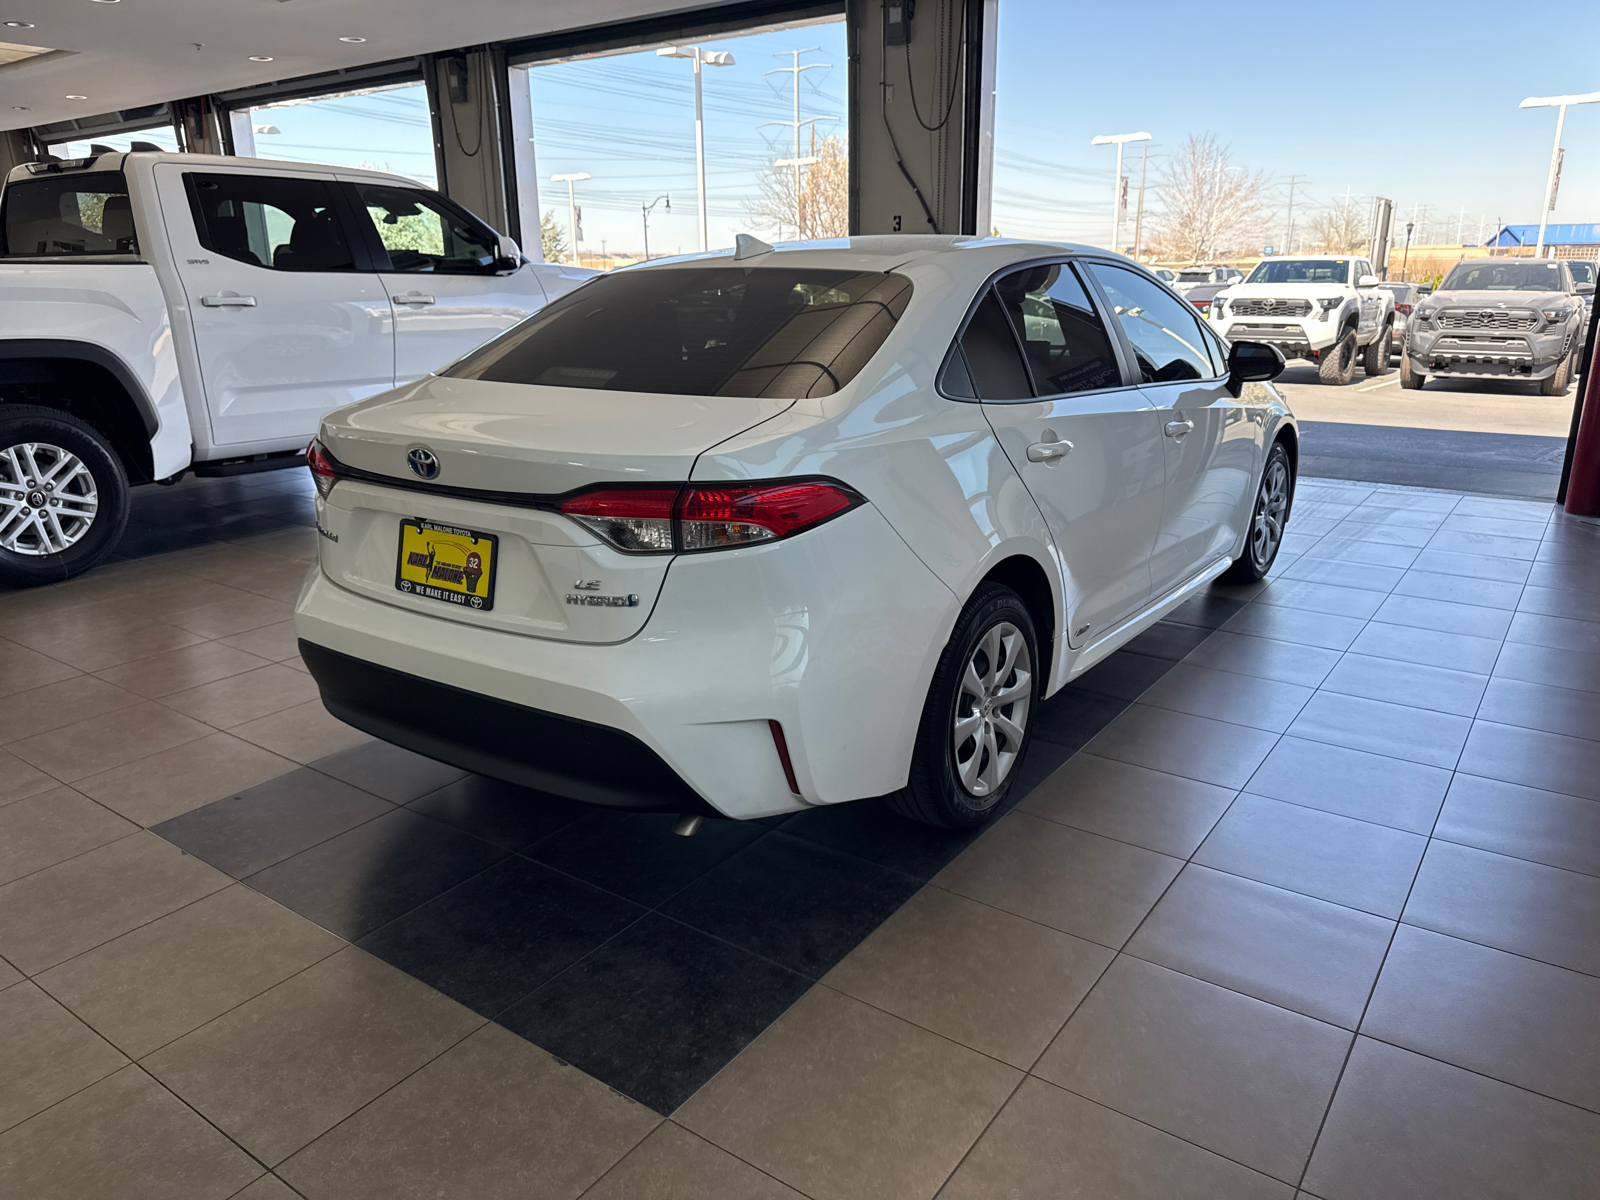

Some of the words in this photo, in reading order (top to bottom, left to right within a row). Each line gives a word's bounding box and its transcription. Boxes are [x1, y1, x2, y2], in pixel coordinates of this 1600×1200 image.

[893, 215, 902, 232] 3
[421, 522, 433, 531] KARL
[434, 525, 453, 534] MALONE
[453, 528, 471, 537] TOYOTA
[407, 551, 429, 568] KARL
[468, 557, 479, 569] 32
[430, 565, 464, 585] MALONE
[574, 579, 601, 590] LE
[415, 585, 425, 595] WE
[425, 586, 442, 598] MAKE
[443, 591, 449, 600] IT
[450, 592, 465, 604] EASY
[566, 593, 627, 607] HYBRID
